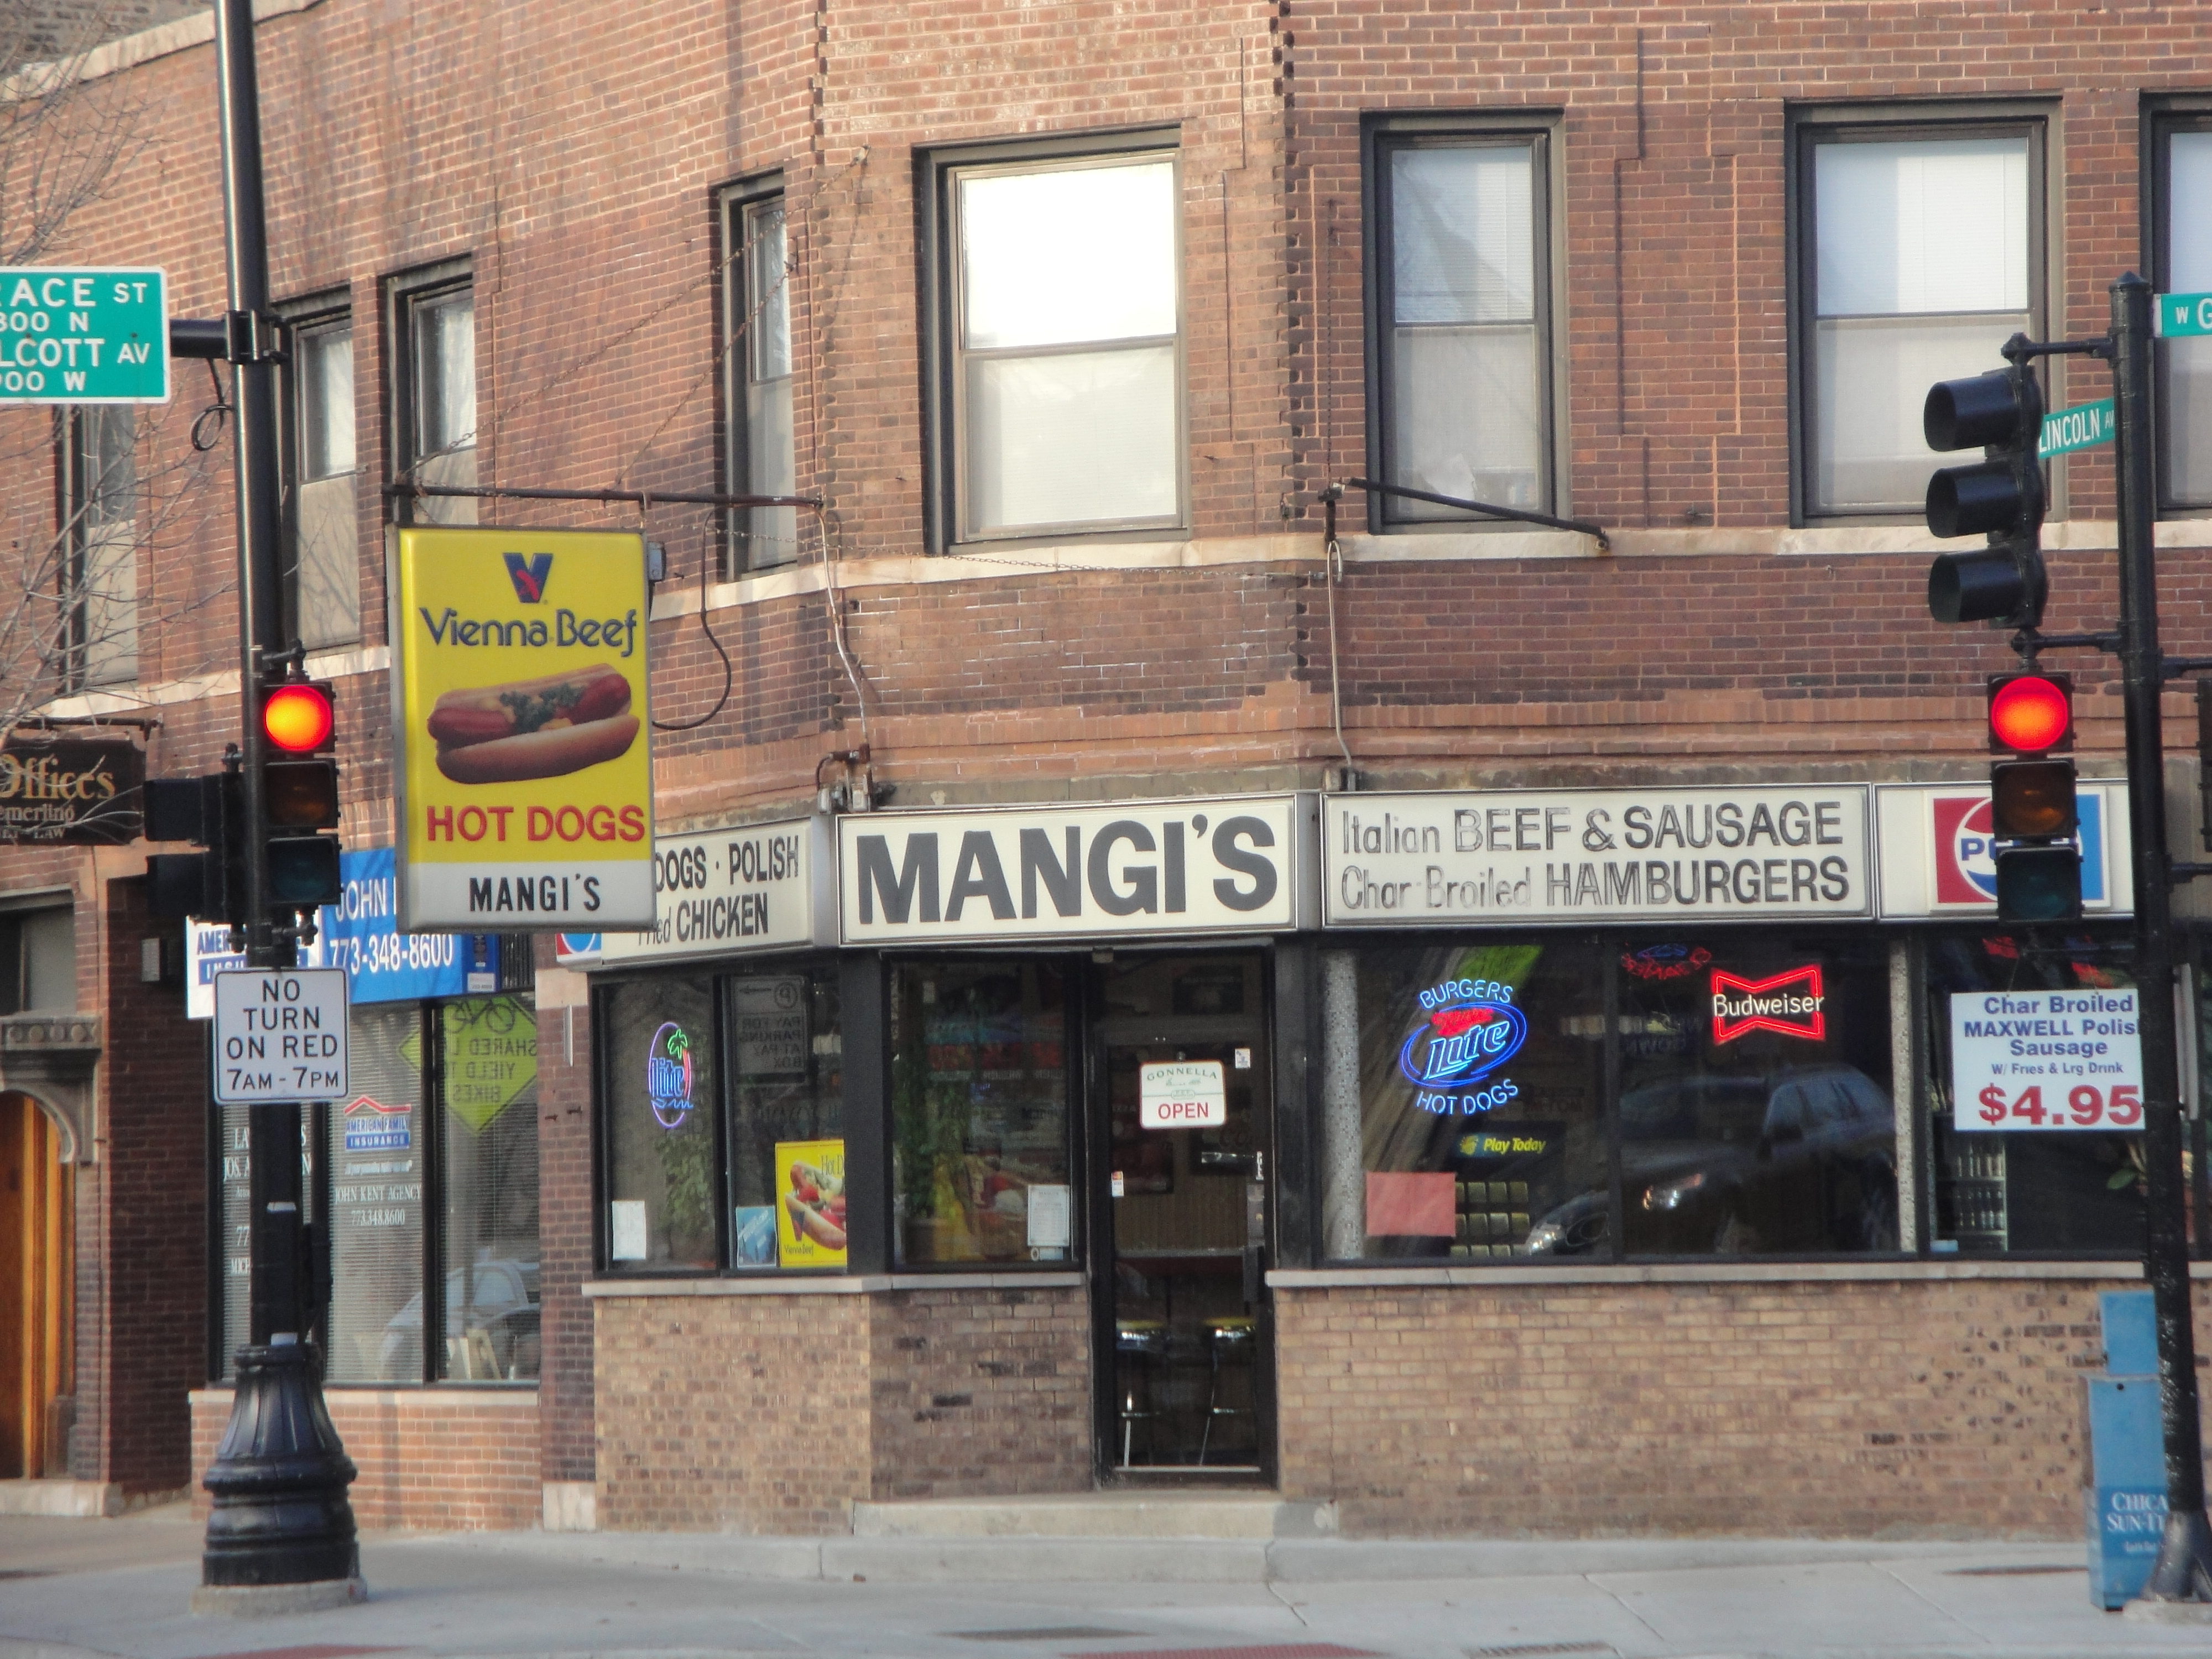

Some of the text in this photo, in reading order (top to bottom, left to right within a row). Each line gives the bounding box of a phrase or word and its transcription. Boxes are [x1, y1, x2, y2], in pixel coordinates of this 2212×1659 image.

[0, 278, 148, 307] ACE ST
[70, 312, 89, 332] N
[2176, 306, 2188, 324] W
[0, 338, 150, 367] LCOTT AV
[0, 371, 86, 392] 00 W
[2039, 408, 2100, 453] LINCOLN
[419, 607, 637, 658] Vienna Beef
[426, 805, 645, 842] HOT DOGS
[1343, 800, 1843, 853] Italian BEEF & SAUSAGE
[728, 835, 799, 885] POLISH
[857, 814, 1277, 924] MANGI'S
[469, 873, 600, 911] MANGI'S
[1426, 864, 1531, 909] Broiled
[1546, 855, 1849, 906] HAMBURGERS
[336, 878, 386, 922] JOHN
[676, 893, 768, 941] CHICKEN
[330, 932, 452, 975] 773-348-8600
[262, 979, 300, 1002] NO
[1420, 979, 1513, 1008] BURGERS
[1713, 993, 1824, 1017] Budweiser
[1984, 995, 2133, 1014] Char Broiled
[243, 1006, 320, 1030] TURN
[1964, 1019, 2140, 1037] MAXWELL Polis
[226, 1034, 337, 1060] ON RED
[1423, 1021, 1510, 1079] Lite
[2010, 1040, 2108, 1058] Sausage
[227, 1068, 272, 1091] 7AM
[293, 1066, 338, 1089] 7PM
[1147, 1067, 1217, 1081] GONNELLA
[2011, 1063, 2044, 1074] Fries
[2049, 1062, 2058, 1074] &
[2063, 1062, 2083, 1076] Lrg
[2089, 1062, 2124, 1073] Drink
[1416, 1091, 1457, 1115] HOT
[1464, 1079, 1518, 1115] DOGS
[1979, 1083, 2142, 1126] $4.95
[1158, 1102, 1209, 1119] OPEN
[350, 1135, 405, 1147] INSURANCE
[1484, 1138, 1546, 1155] Play Today
[335, 1184, 422, 1204] JOHN KENT AGENCY
[2112, 1493, 2169, 1511] CHICA
[2107, 1511, 2164, 1532] SUN-TI
